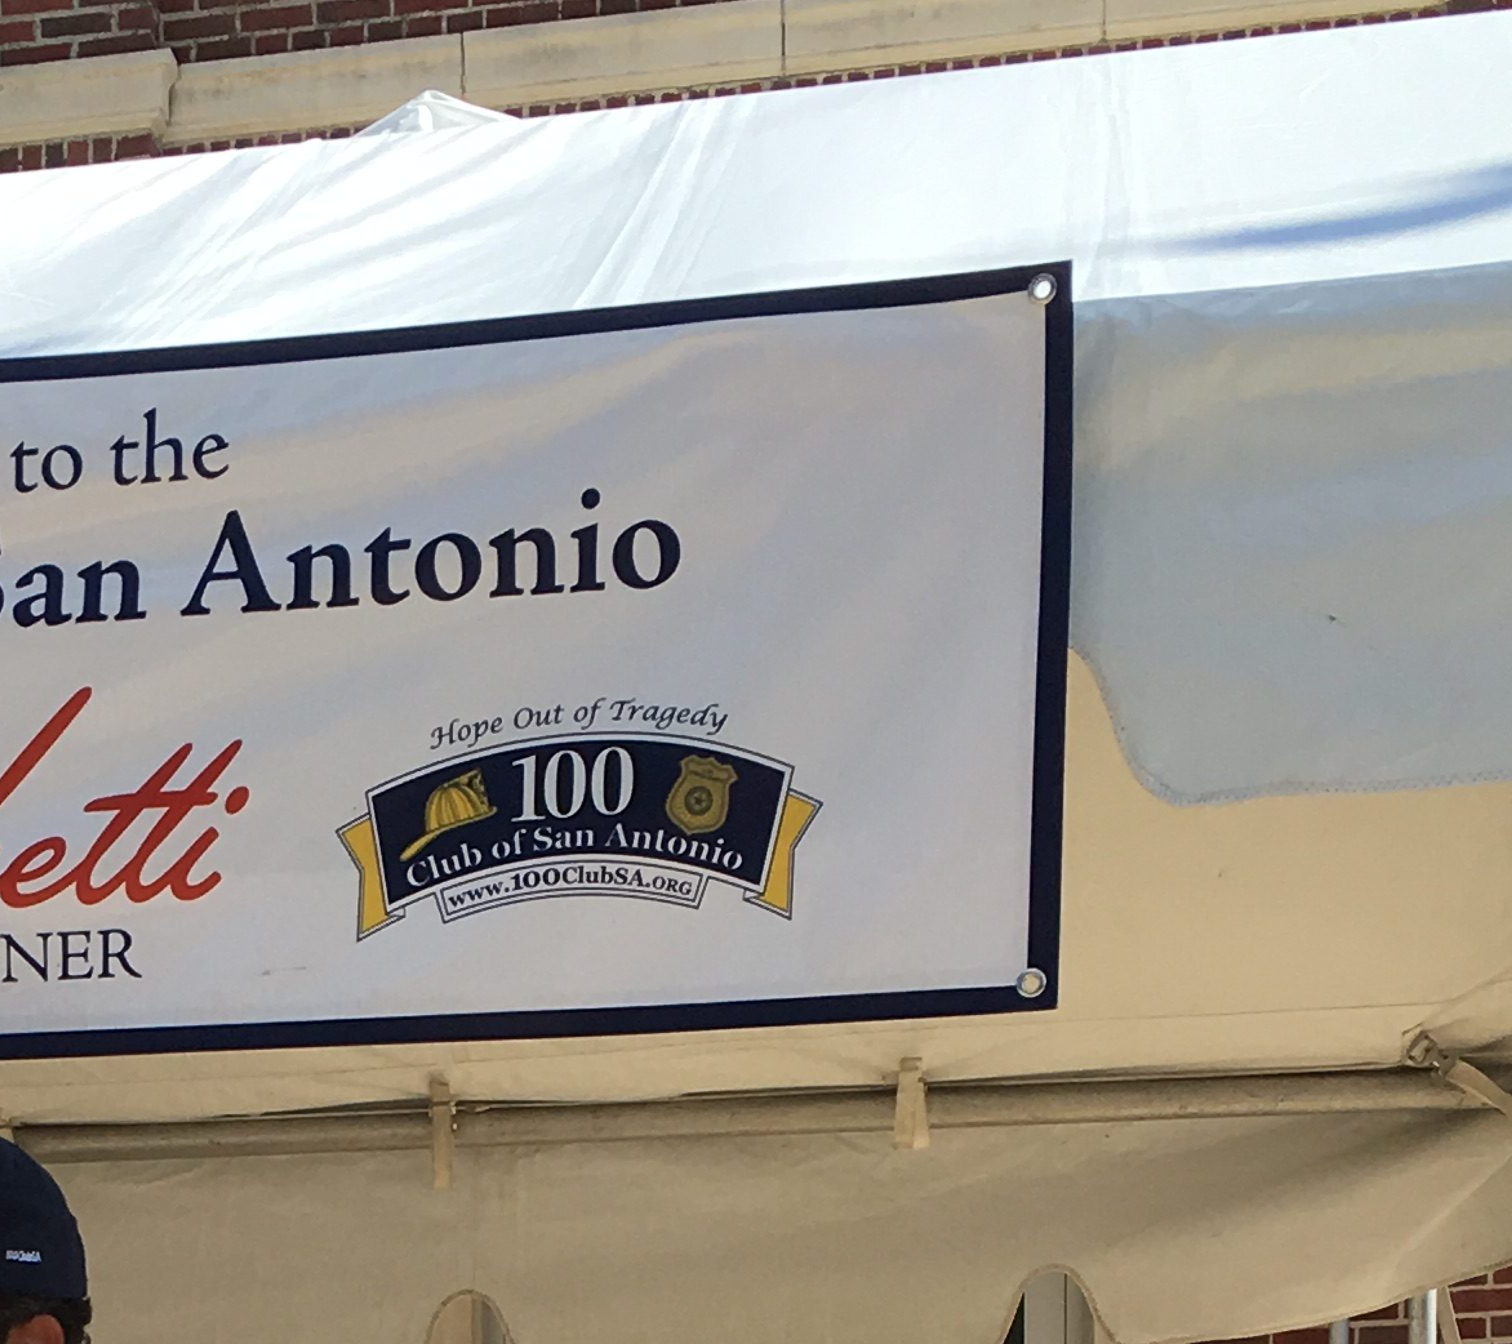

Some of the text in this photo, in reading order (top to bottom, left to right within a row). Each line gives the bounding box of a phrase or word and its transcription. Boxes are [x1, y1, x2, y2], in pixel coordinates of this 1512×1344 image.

[11, 439, 84, 492] to
[110, 408, 231, 486] the
[179, 486, 684, 618] Antonio
[429, 697, 730, 750] Hope Out of Tragedy
[510, 745, 635, 823] 100
[405, 821, 744, 889] Club of San Antonio
